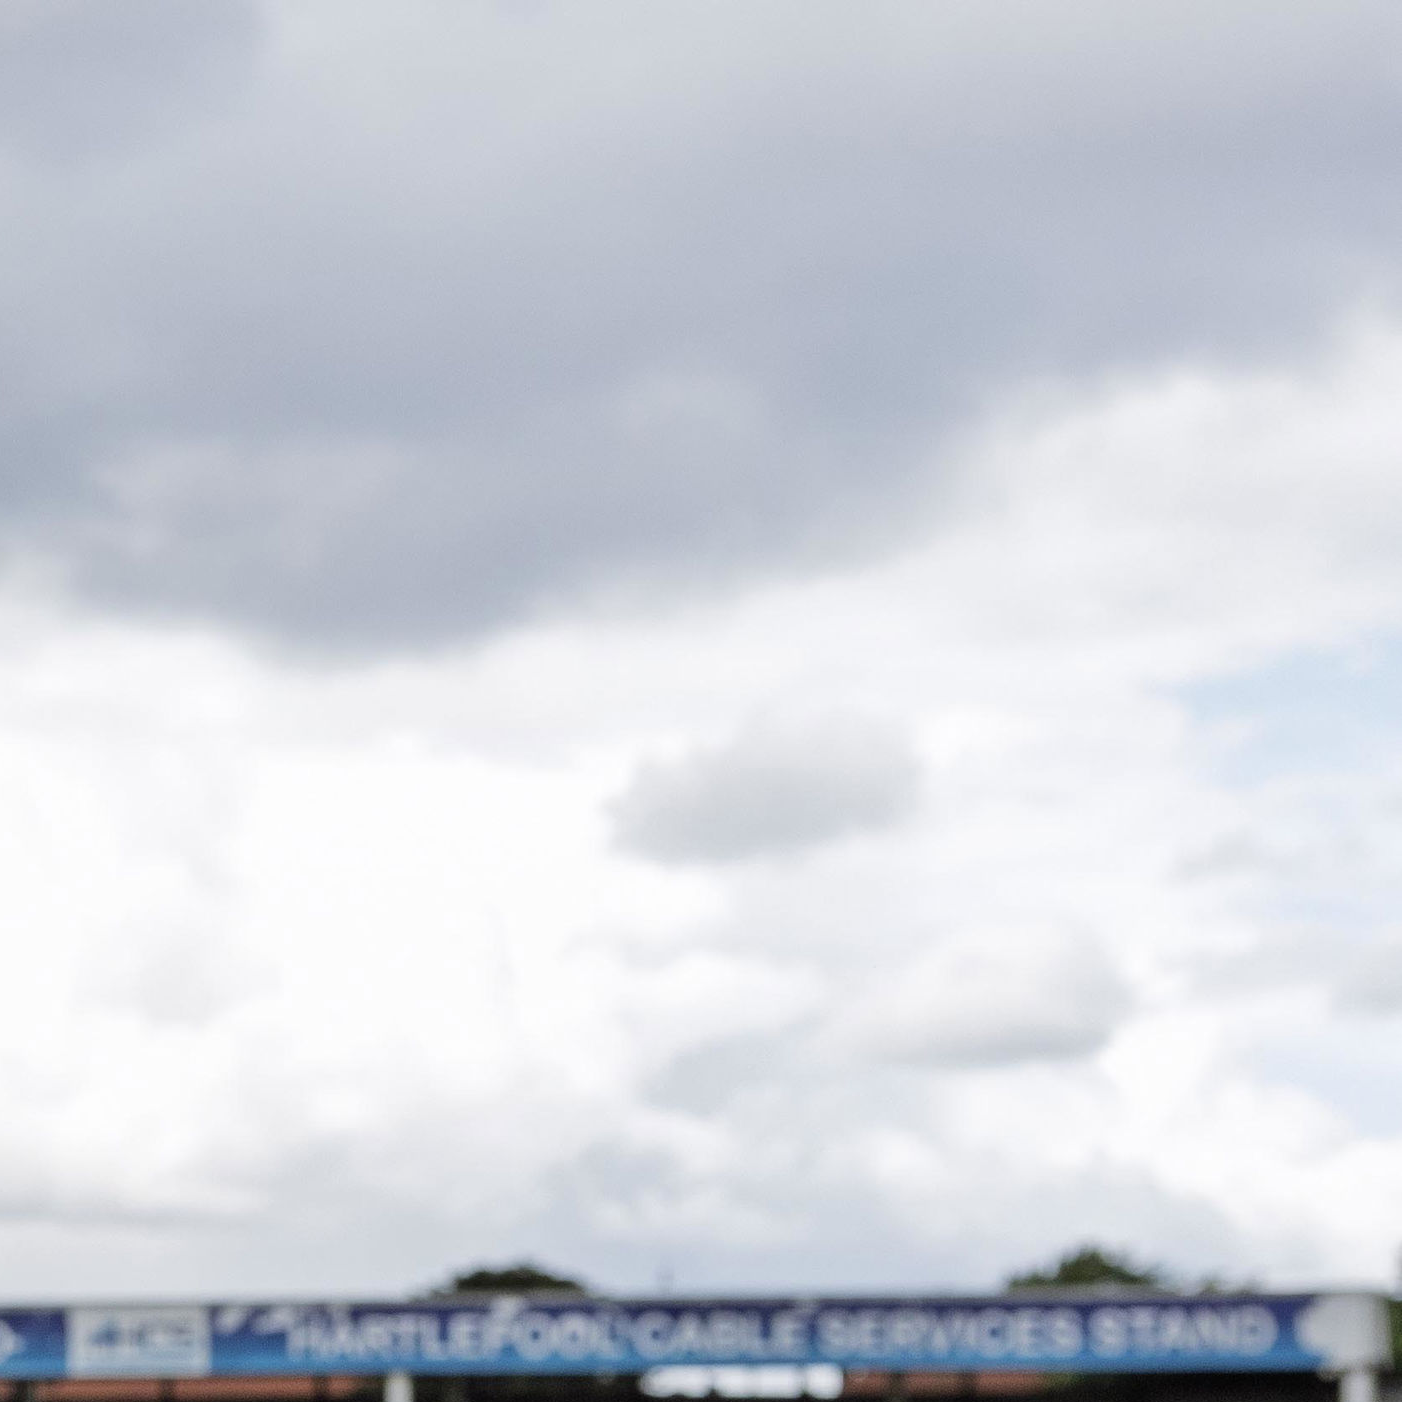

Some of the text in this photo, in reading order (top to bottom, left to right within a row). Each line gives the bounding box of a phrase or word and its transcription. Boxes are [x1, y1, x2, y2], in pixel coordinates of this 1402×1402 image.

[288, 1305, 1279, 1361] HARTLEPOOL CABLE SERVICES STAND
